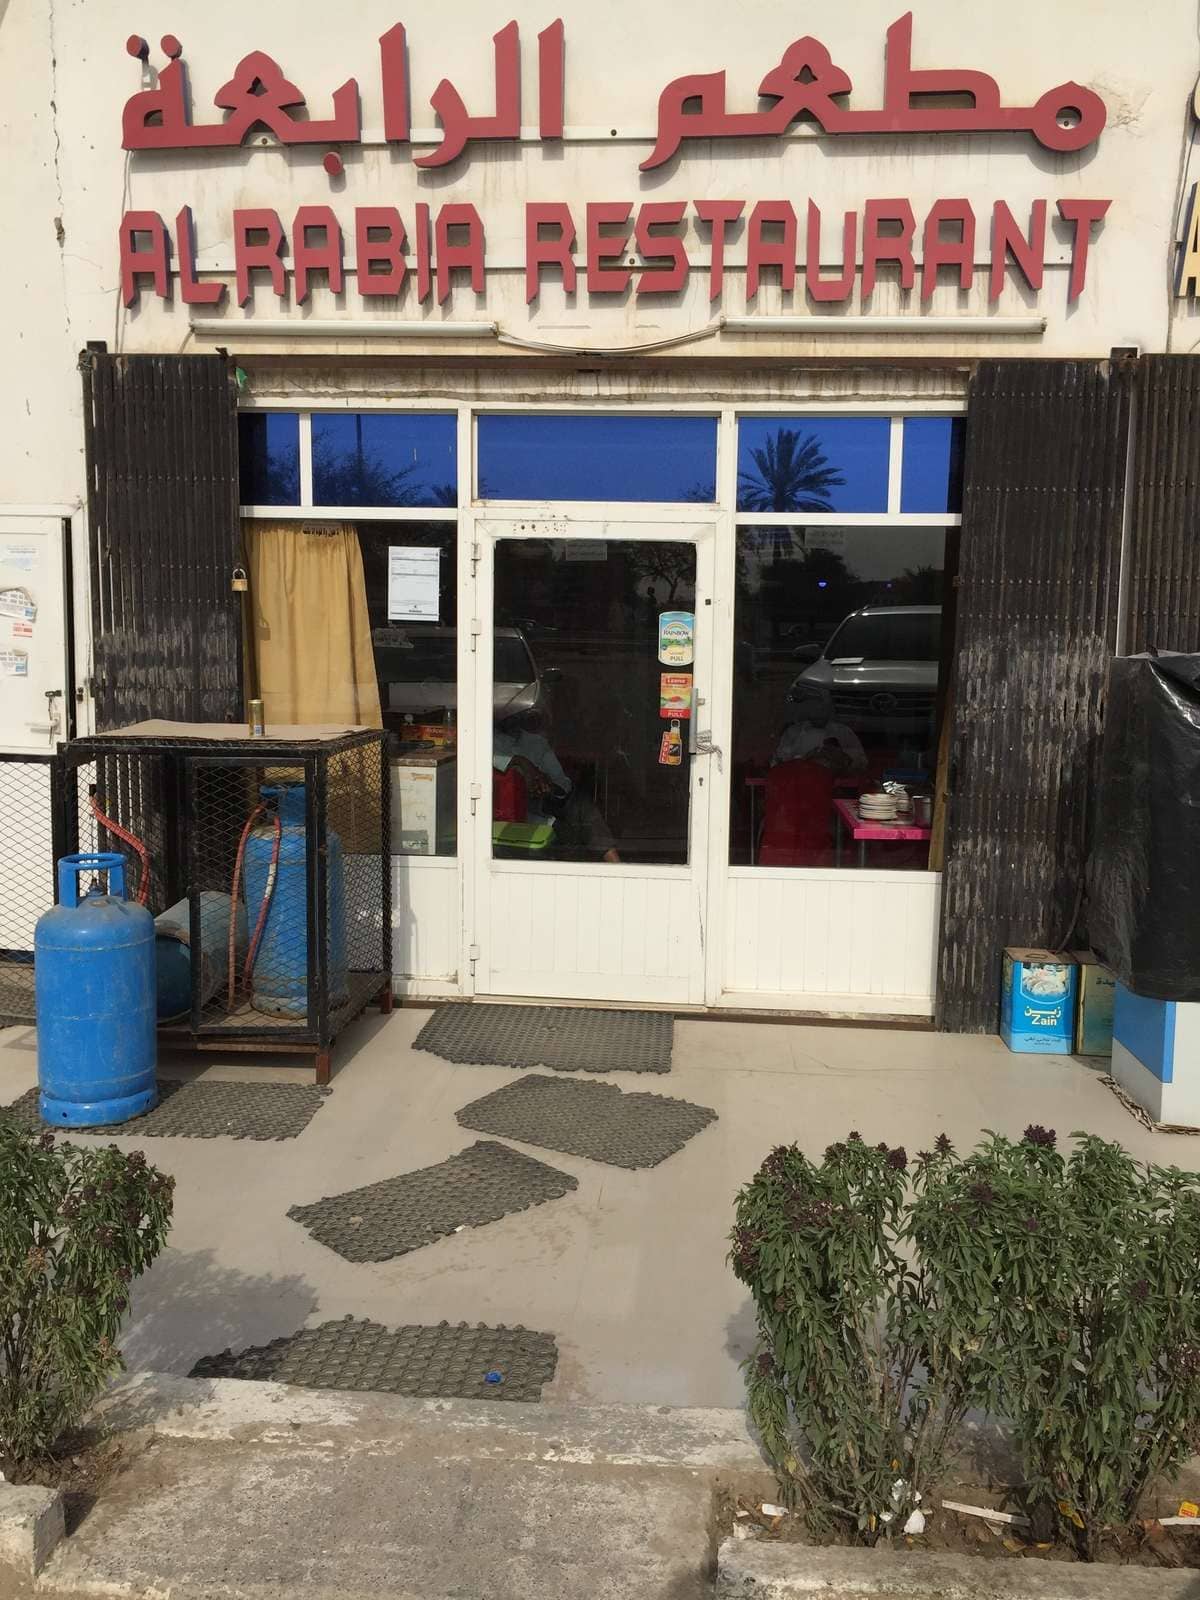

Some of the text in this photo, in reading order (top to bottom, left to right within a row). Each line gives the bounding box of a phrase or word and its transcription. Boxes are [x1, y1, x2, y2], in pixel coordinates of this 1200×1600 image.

[122, 11, 1108, 177] مطعم الرابعة
[525, 197, 1113, 305] RESTAURANT
[1024, 1005, 1062, 1018] زين
[1031, 1014, 1057, 1026] Zain
